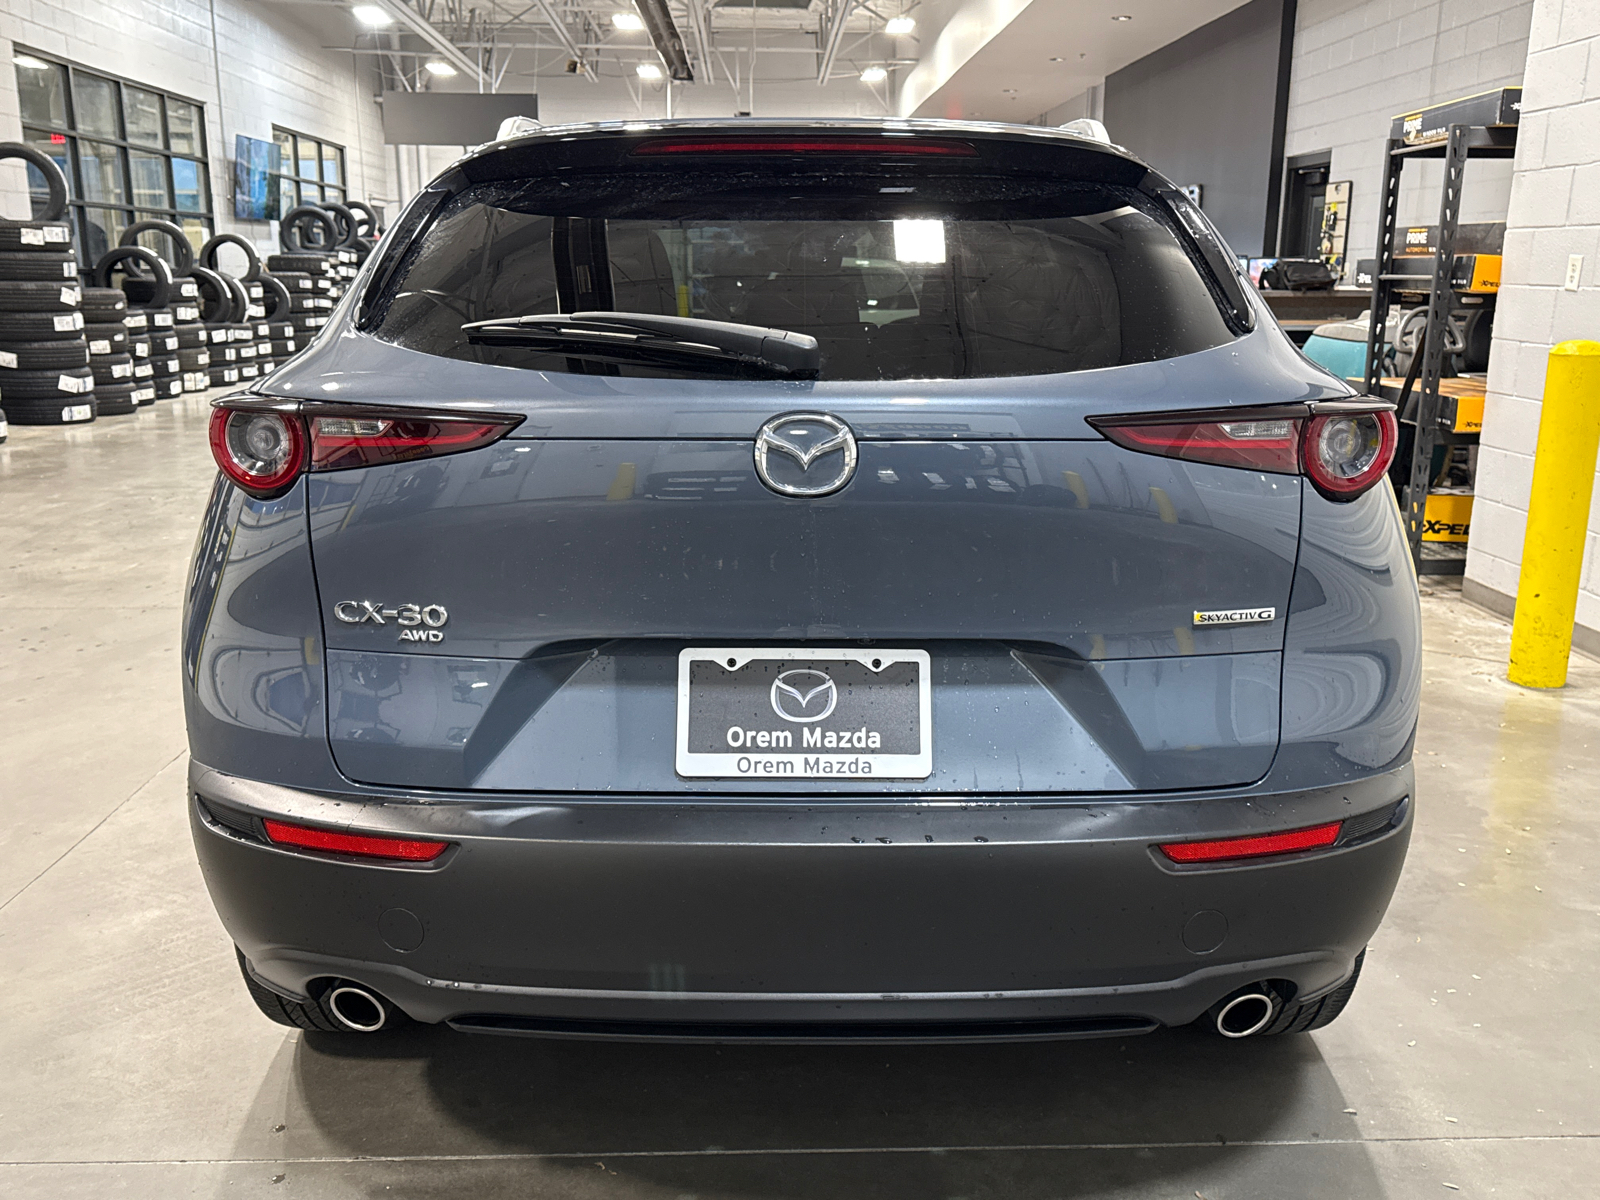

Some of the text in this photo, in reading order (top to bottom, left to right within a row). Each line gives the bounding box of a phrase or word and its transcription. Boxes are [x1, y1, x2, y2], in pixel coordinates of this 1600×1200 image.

[334, 600, 448, 627] CX-30
[398, 630, 444, 642] AWD
[727, 726, 881, 748] Orem Mazda
[737, 757, 872, 774] Orem Mazda
